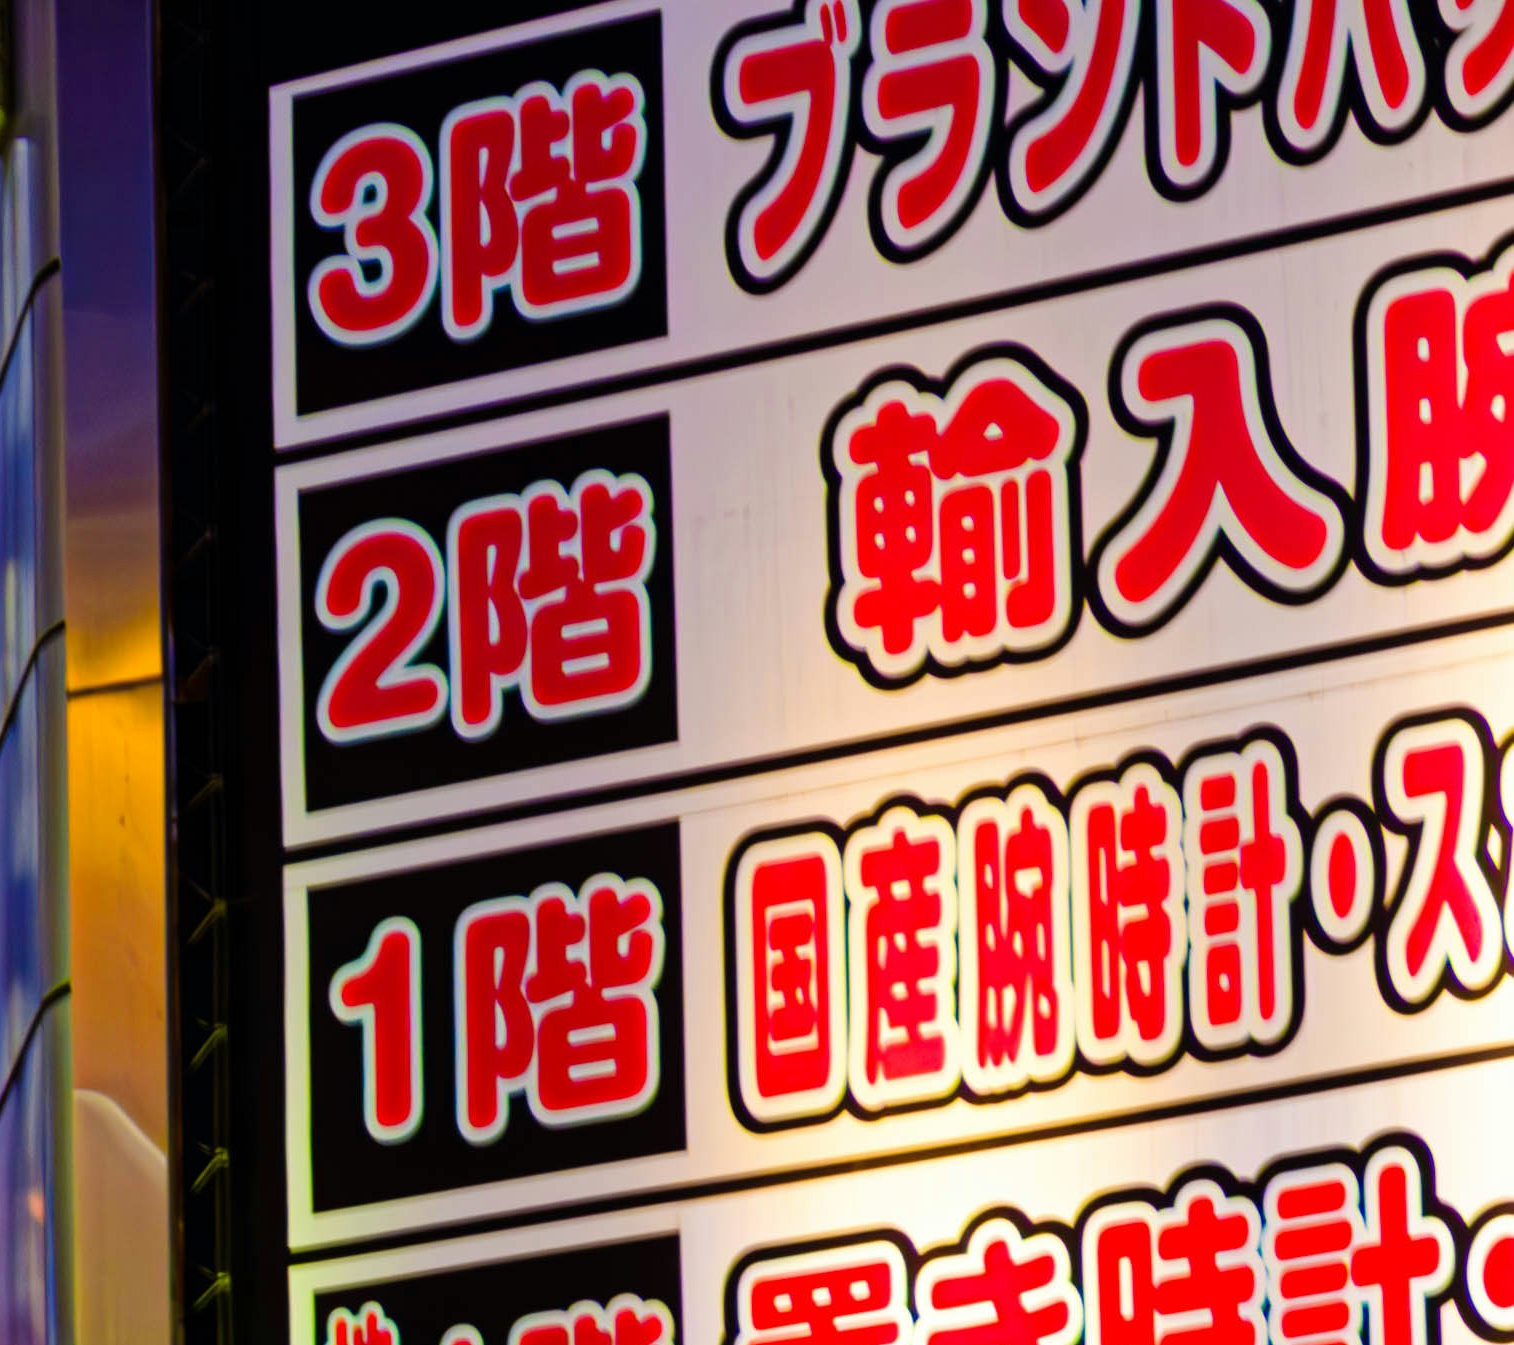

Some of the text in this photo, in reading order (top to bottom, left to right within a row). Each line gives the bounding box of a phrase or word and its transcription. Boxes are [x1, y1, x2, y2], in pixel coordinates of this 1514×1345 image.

[310, 69, 648, 346] 3階
[317, 469, 658, 744] 2階
[330, 872, 663, 1144] 1階
[730, 704, 1514, 1128] 国産腕時計・ス
